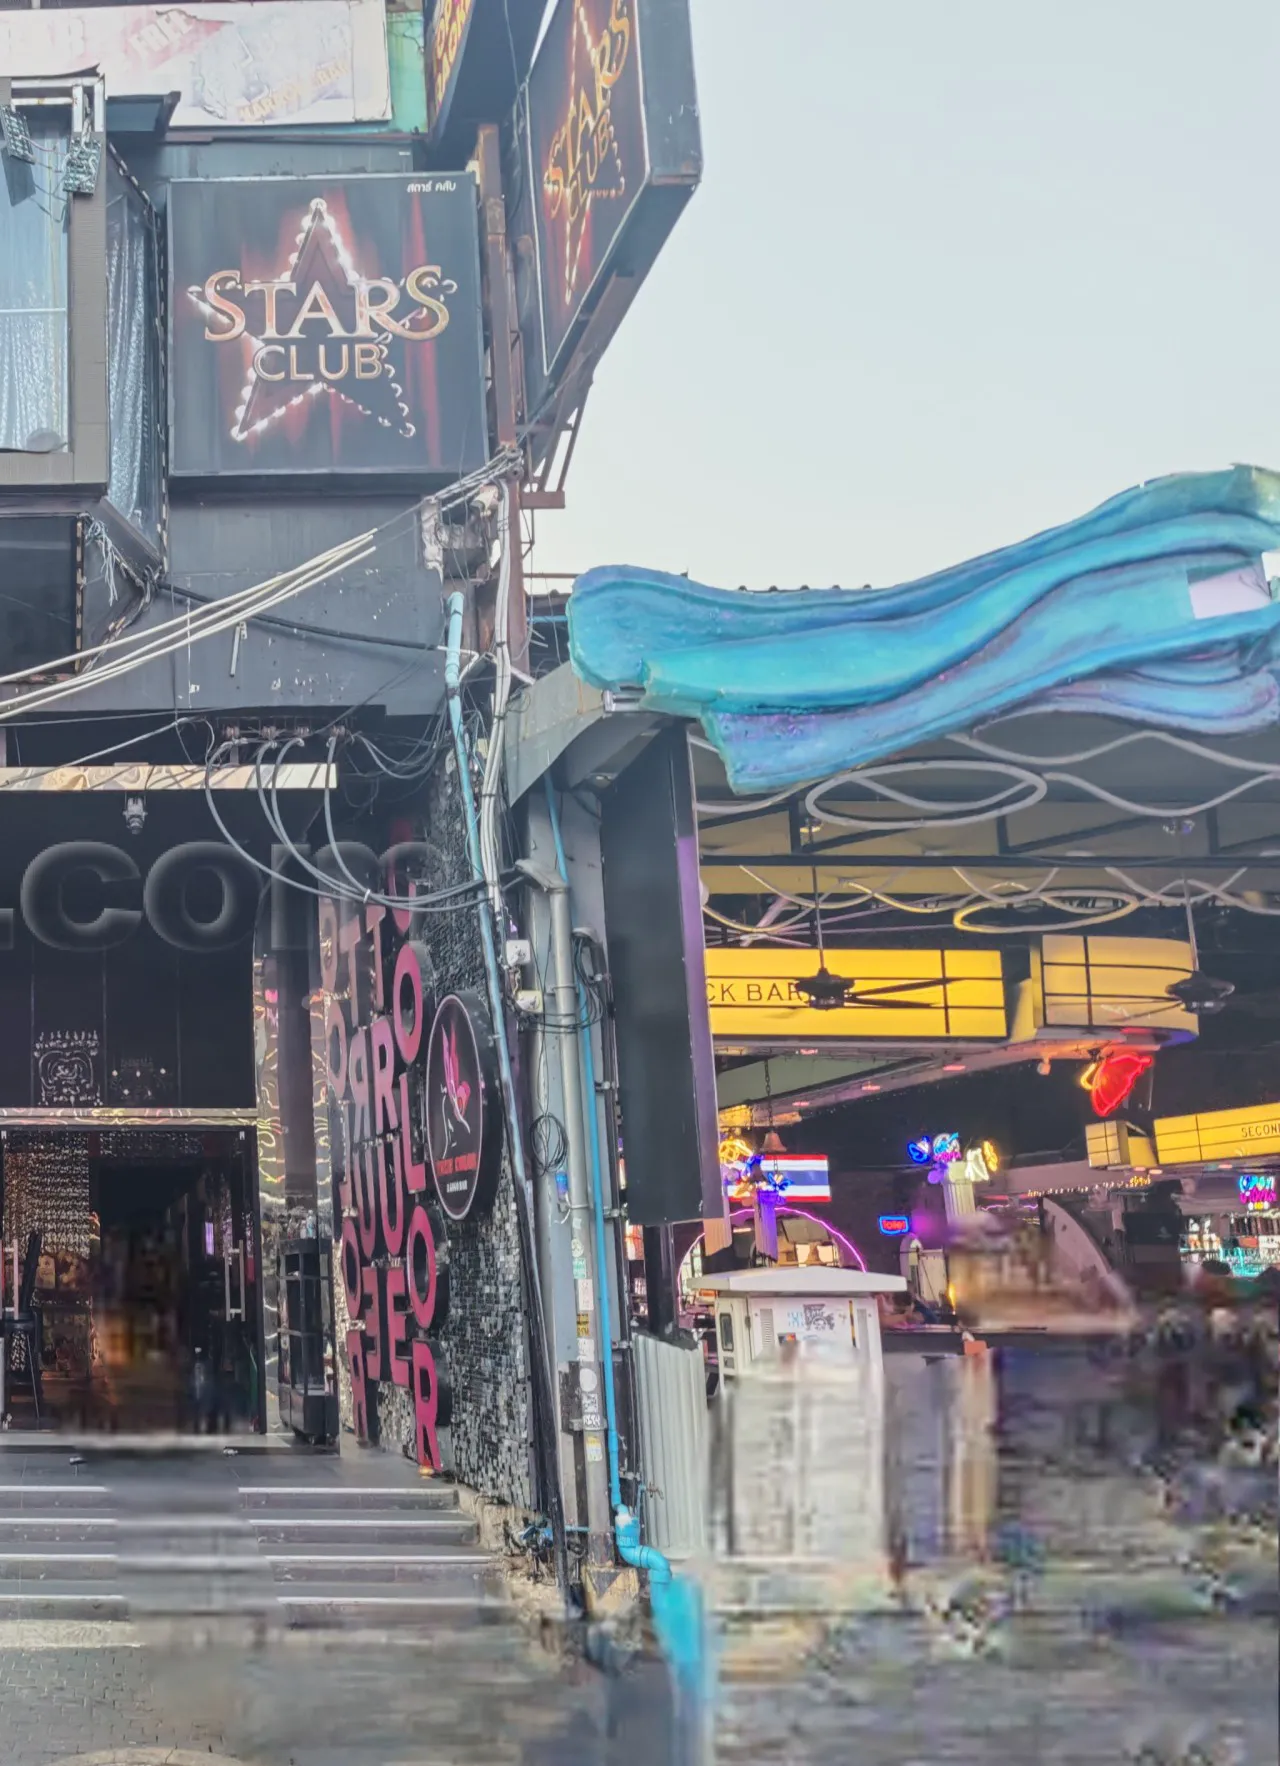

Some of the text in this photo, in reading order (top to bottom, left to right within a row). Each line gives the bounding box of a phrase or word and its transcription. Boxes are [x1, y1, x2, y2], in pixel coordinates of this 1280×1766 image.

[546, 2, 631, 220] STARS
[569, 111, 611, 221] CLUB
[204, 264, 450, 341] STARS
[252, 343, 384, 382] CLUB
[746, 982, 803, 1002] BAR
[365, 903, 413, 1388] TRUE
